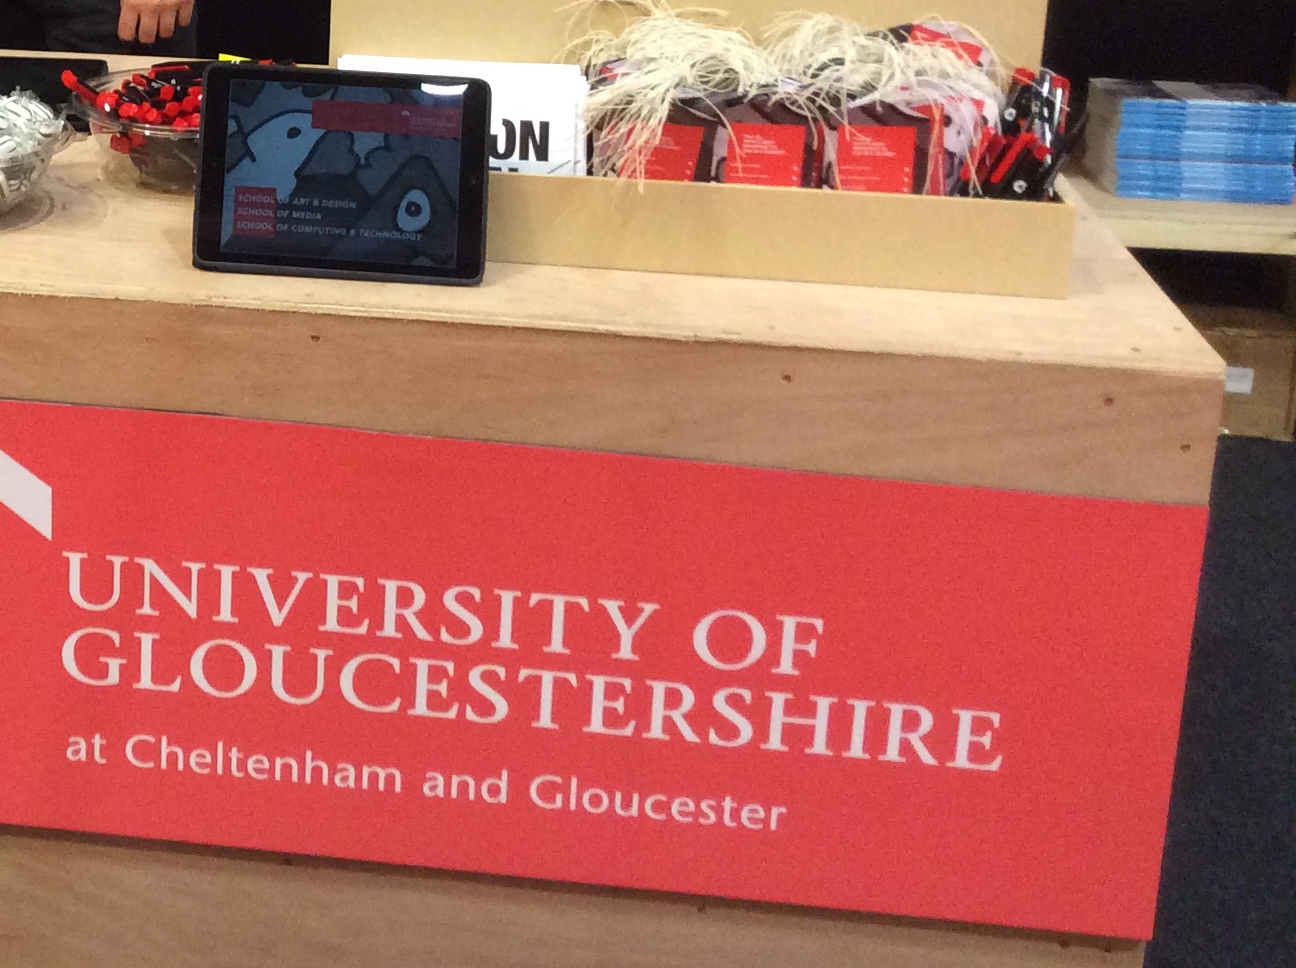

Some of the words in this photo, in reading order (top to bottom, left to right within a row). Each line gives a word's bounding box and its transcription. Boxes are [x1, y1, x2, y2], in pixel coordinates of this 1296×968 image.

[236, 221, 274, 230] SCHOOL
[276, 223, 289, 231] OF
[291, 224, 346, 235] COMPUTING
[359, 228, 423, 241] TECHNOLOGY
[237, 207, 274, 216] SCHOOL
[276, 210, 290, 218] OF
[292, 211, 322, 220] MEDIA
[238, 194, 275, 203] SCHOOL
[292, 198, 310, 206] ART
[322, 200, 357, 209] DESIGN
[62, 551, 660, 662] UNIVERSITY
[692, 609, 824, 677] OF
[61, 627, 1002, 773] GLOUCESTERSHIRE
[66, 733, 106, 765] at
[124, 734, 403, 795] Cheltenham
[422, 768, 507, 804] and
[529, 774, 787, 833] Gloucester
